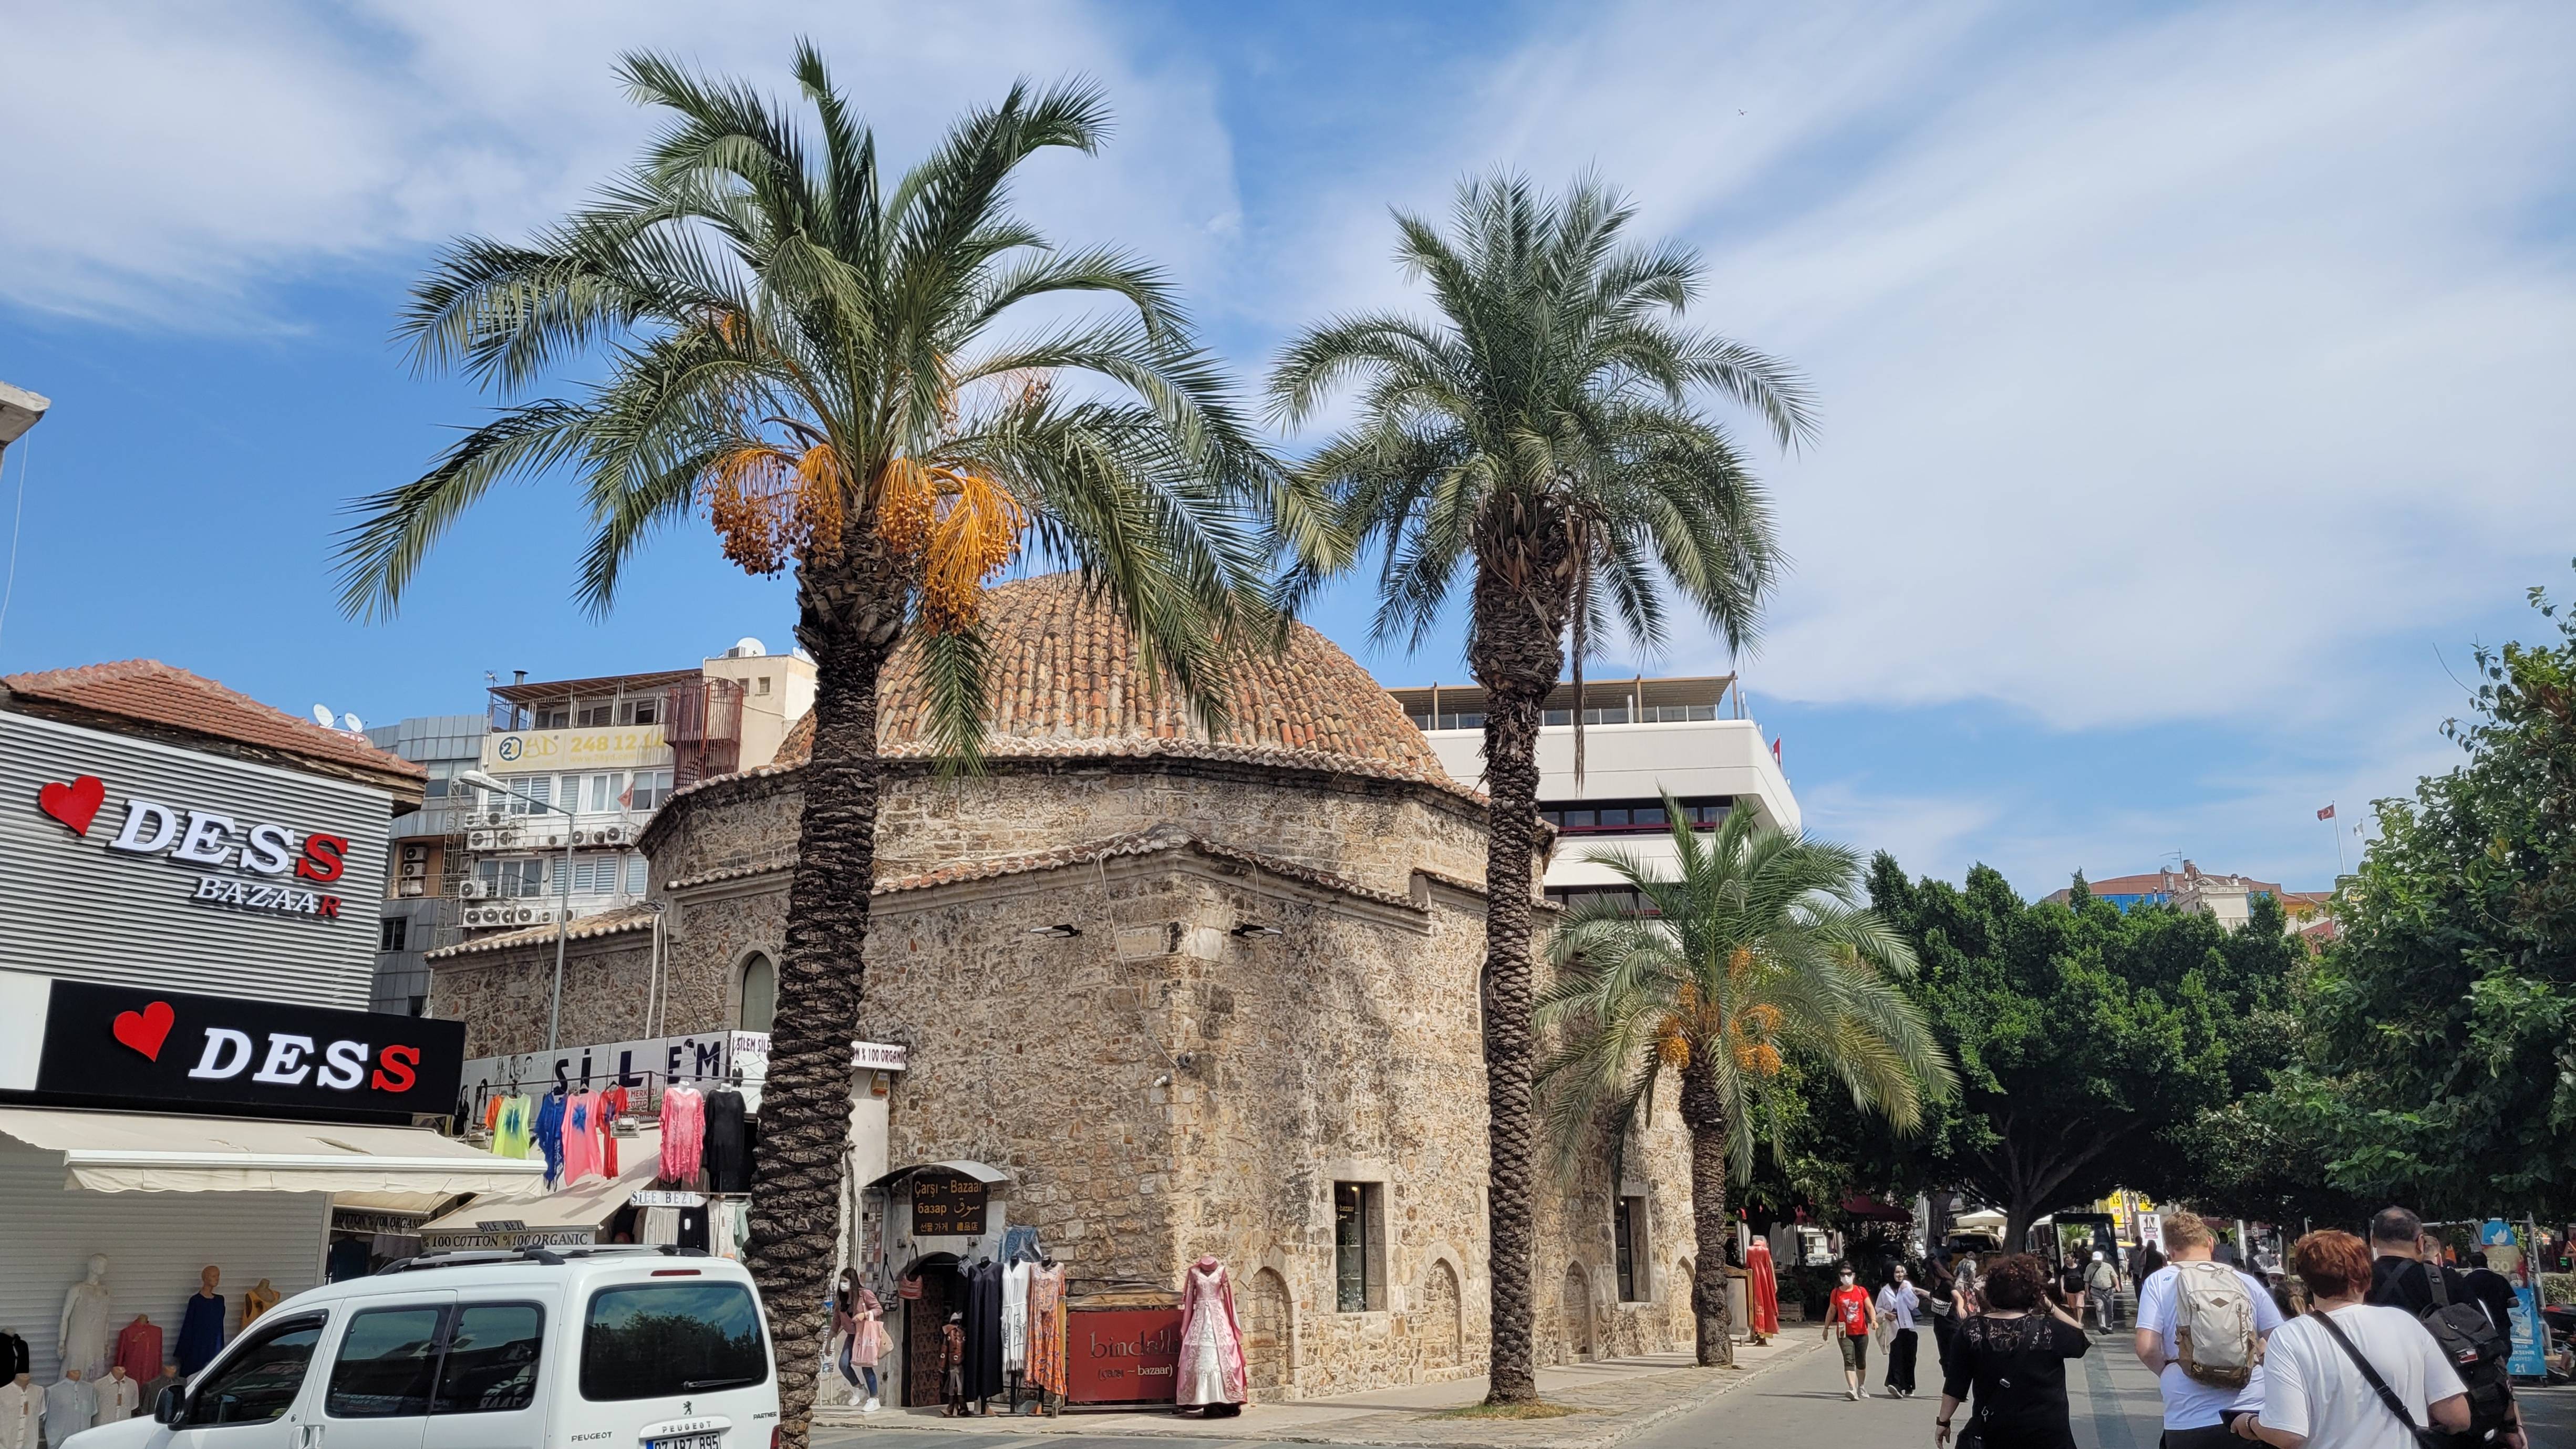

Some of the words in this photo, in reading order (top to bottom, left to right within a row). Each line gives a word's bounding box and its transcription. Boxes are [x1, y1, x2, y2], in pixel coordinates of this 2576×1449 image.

[571, 736, 609, 752] 248
[613, 734, 637, 751] 12
[108, 799, 348, 882] DESS
[196, 876, 342, 918] BAZAAR
[188, 1027, 420, 1092] DESS
[868, 1048, 880, 1062] 100
[915, 1181, 938, 1198] Çarşı
[950, 1179, 982, 1193] Bazaar
[918, 1202, 947, 1216] базар
[954, 1197, 980, 1218] سوق
[376, 1214, 388, 1226] 100
[432, 1236, 451, 1247] 100
[453, 1235, 499, 1247] COTTON
[532, 1233, 588, 1246] ORGANIC
[1137, 1364, 1173, 1378] bazaar)
[753, 1411, 777, 1420] PARTNER
[661, 1421, 711, 1434] PEUGEOT
[571, 1431, 613, 1443] PEUGEOT
